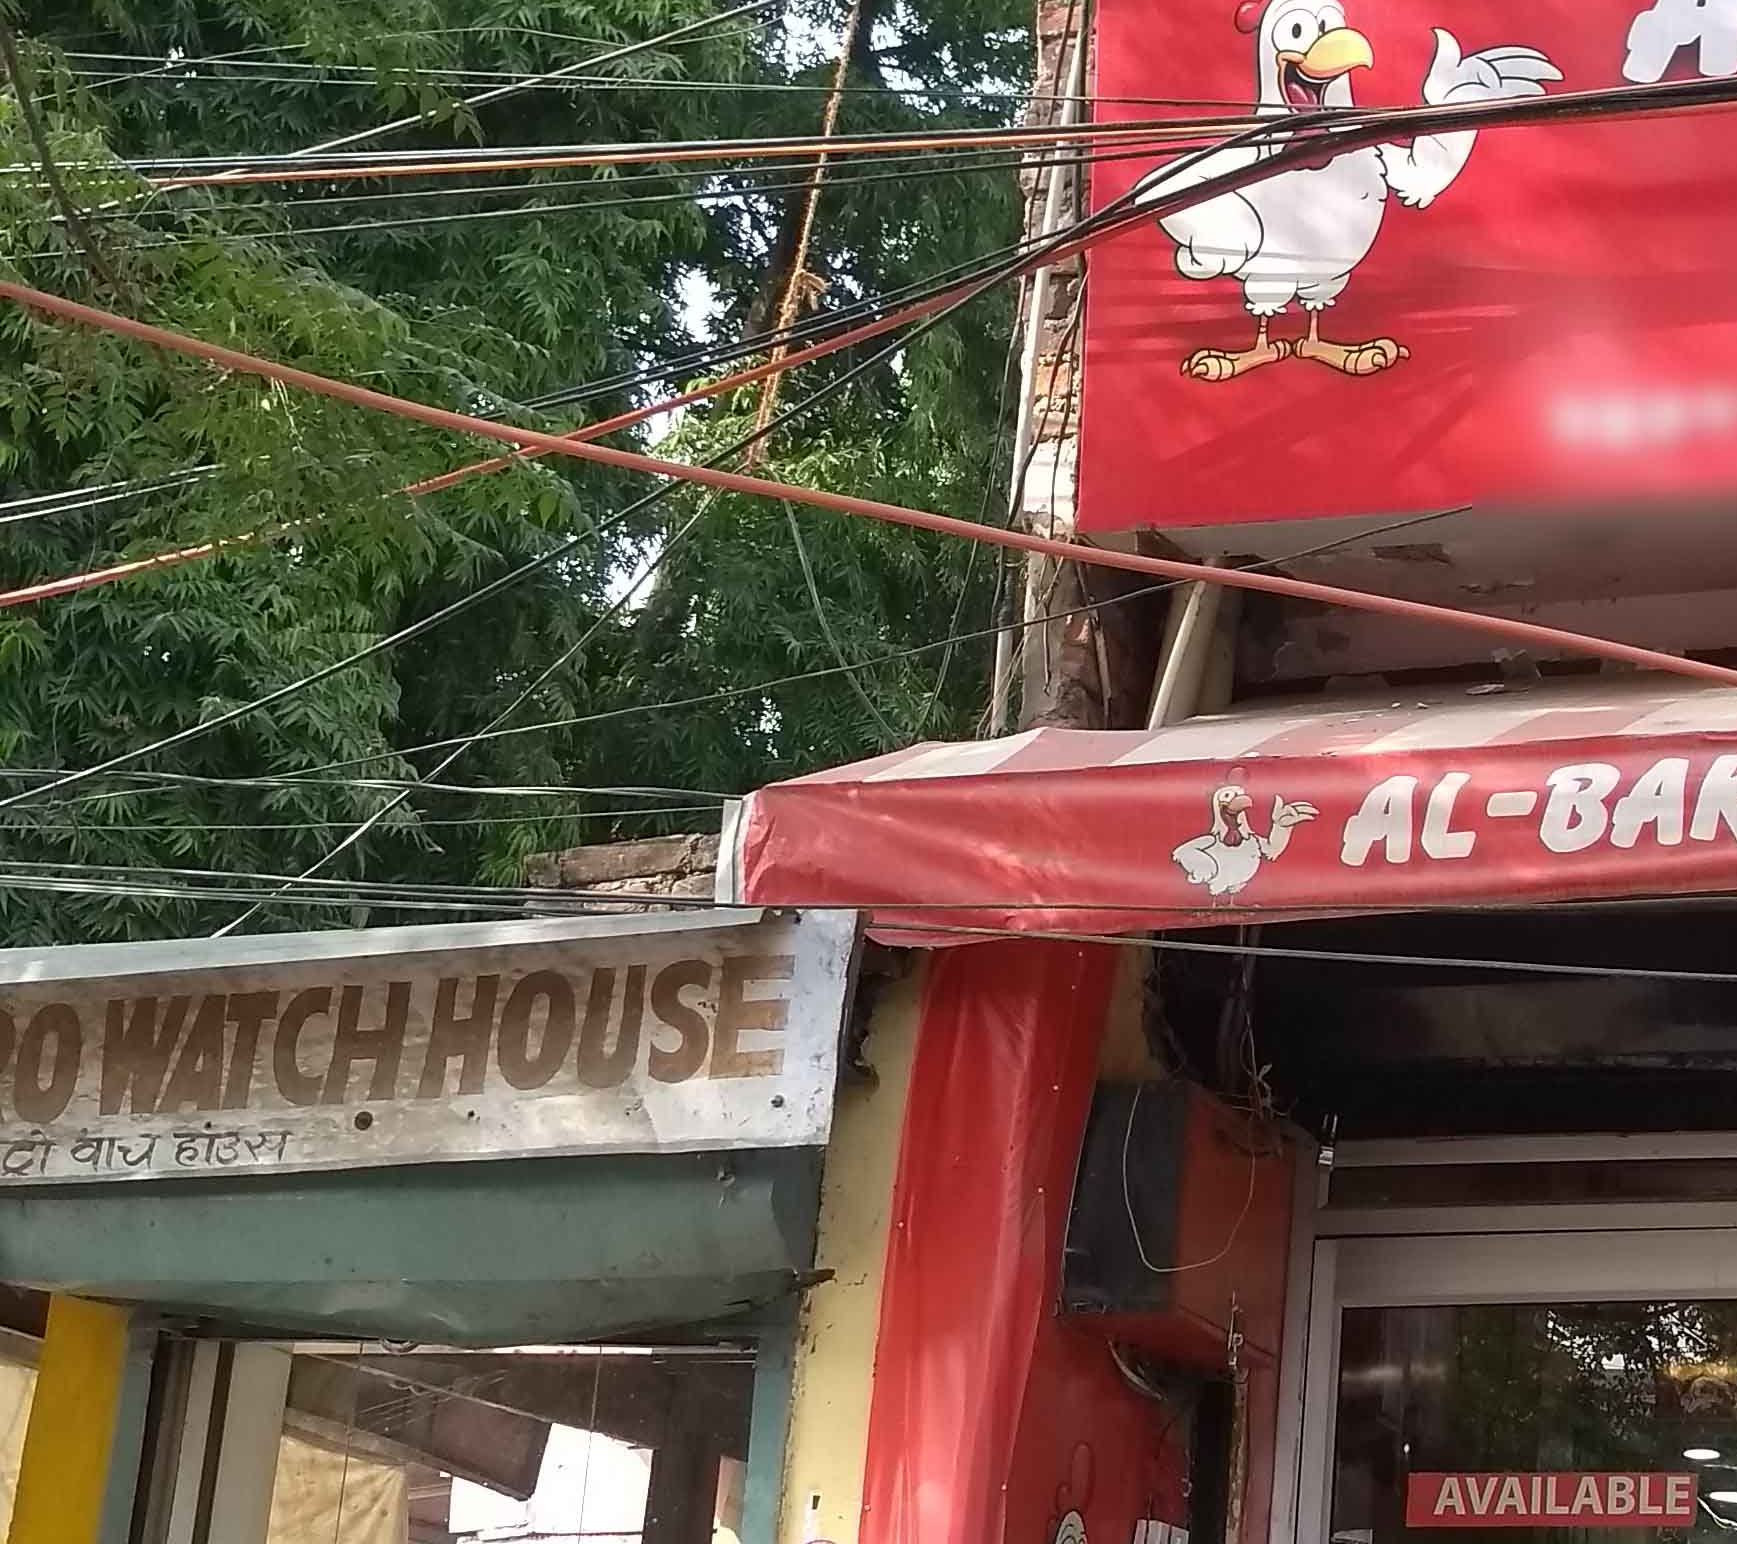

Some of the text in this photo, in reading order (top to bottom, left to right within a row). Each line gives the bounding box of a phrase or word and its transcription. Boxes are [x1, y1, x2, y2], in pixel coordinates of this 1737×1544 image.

[100, 979, 411, 1116] WATCH
[420, 954, 796, 1101] HOUSE
[1432, 1475, 1691, 1516] AVAILABLE
